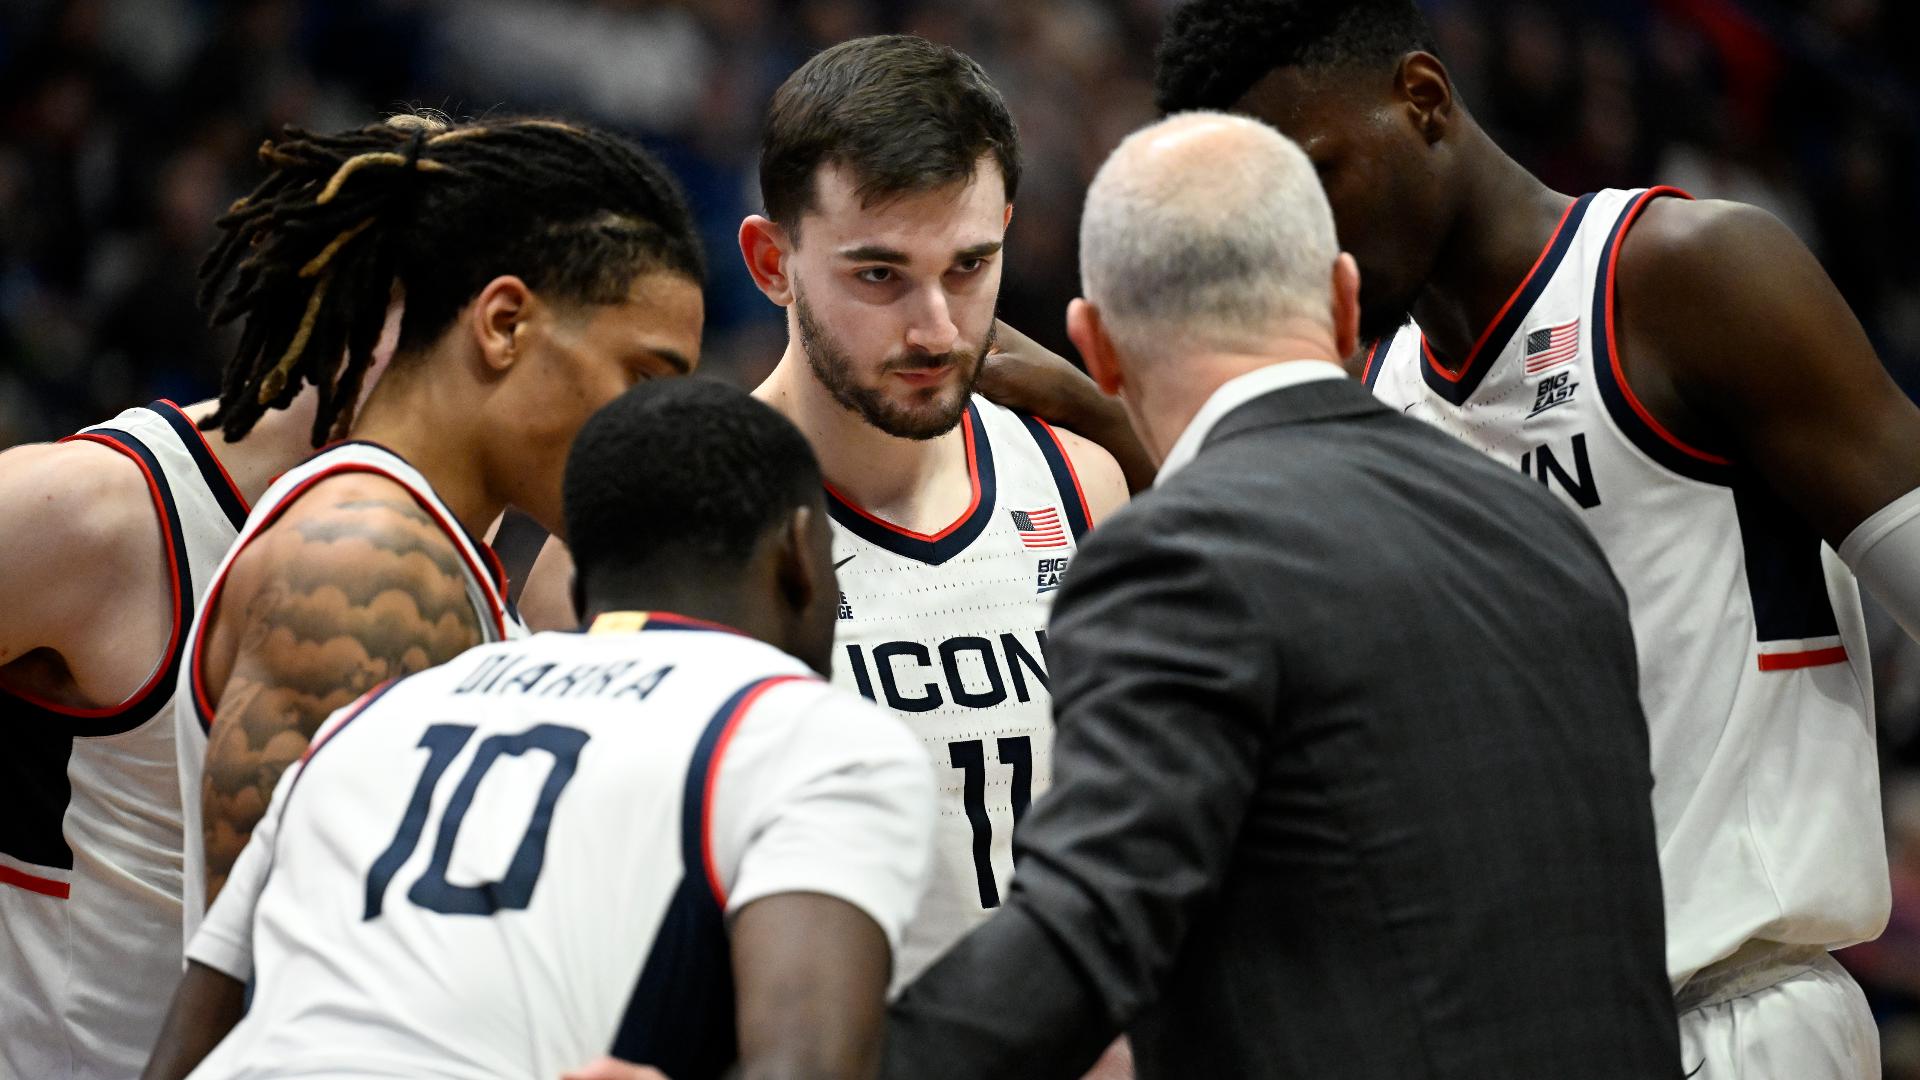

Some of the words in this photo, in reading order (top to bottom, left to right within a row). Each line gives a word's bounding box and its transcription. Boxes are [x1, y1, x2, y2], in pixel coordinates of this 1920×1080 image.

[1532, 382, 1579, 412] EAST
[1537, 371, 1569, 397] BIG
[1038, 557, 1068, 572] BIG
[453, 654, 677, 701] DIARRA
[362, 722, 591, 922] 10
[948, 736, 1032, 909] 11
